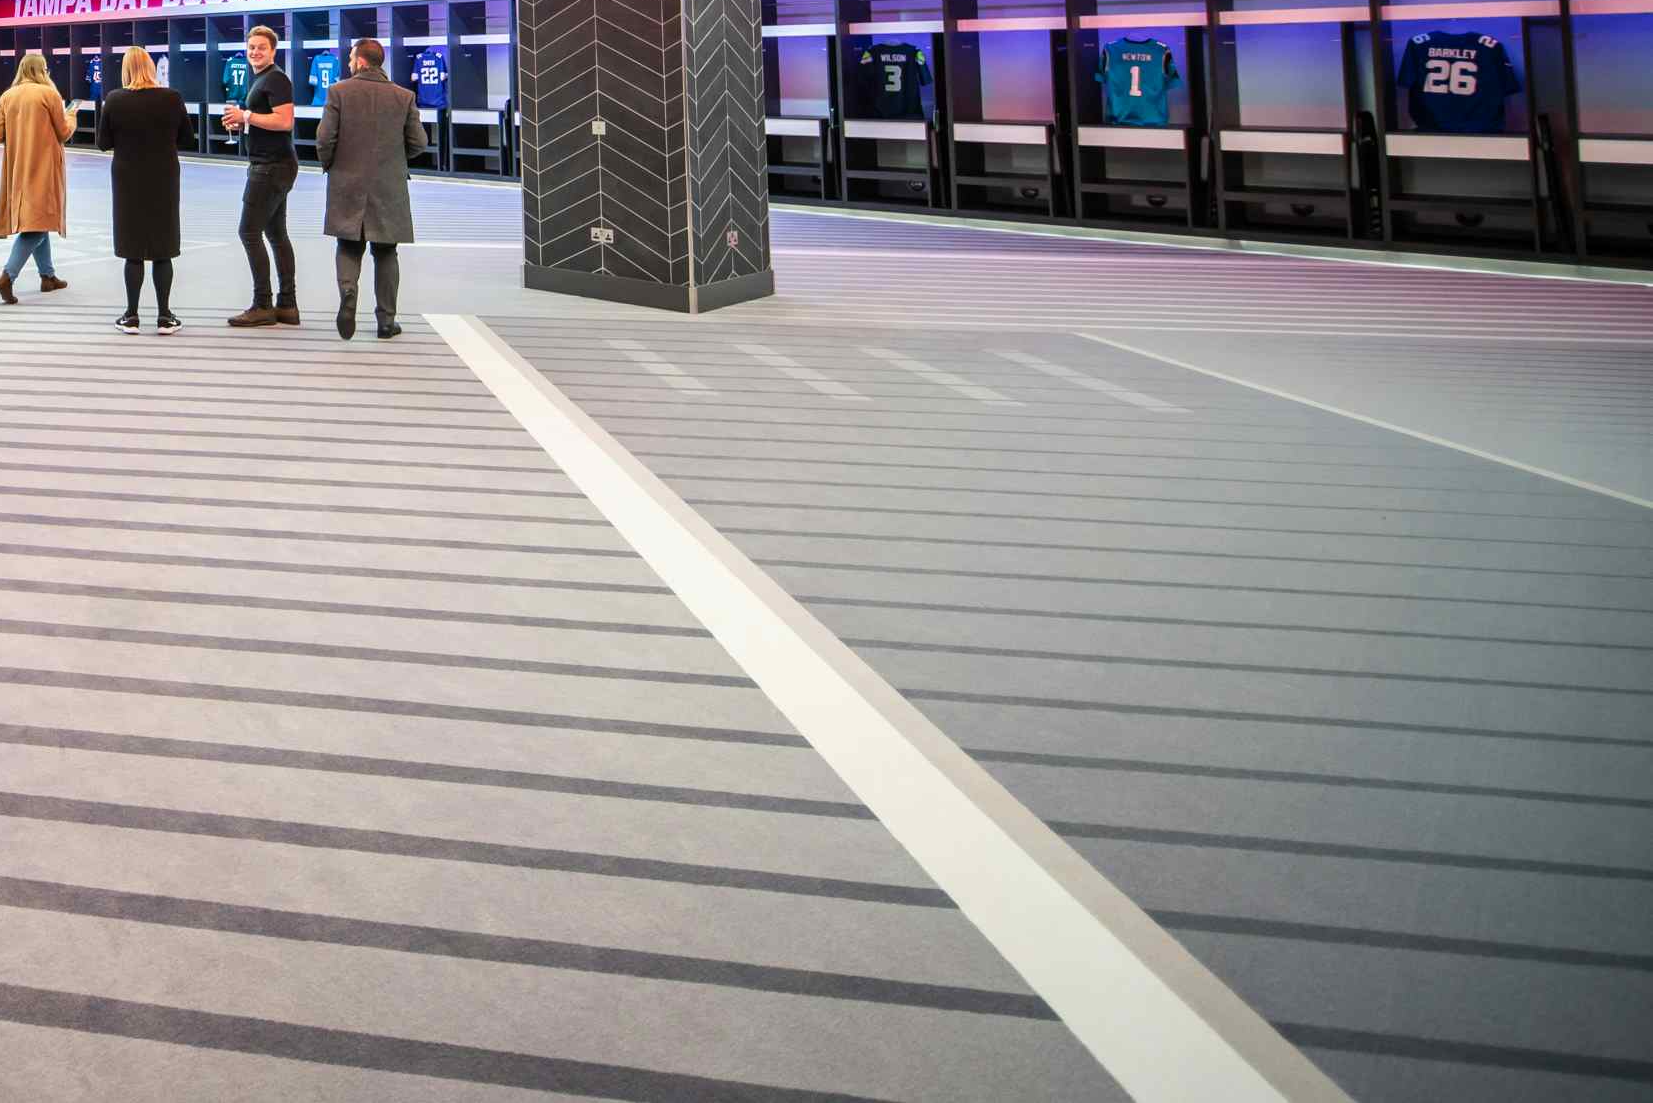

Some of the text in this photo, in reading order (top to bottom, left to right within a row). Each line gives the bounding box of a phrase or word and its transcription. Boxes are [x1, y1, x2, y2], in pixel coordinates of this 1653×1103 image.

[881, 54, 907, 62] WILSON
[1122, 53, 1152, 62] NEWTON
[1428, 47, 1477, 59] BARKLEY
[232, 70, 245, 86] 17
[321, 70, 329, 88] 9
[420, 67, 438, 85] 22
[884, 65, 902, 91] 3
[1129, 66, 1142, 97] 1
[1423, 59, 1478, 95] 26
